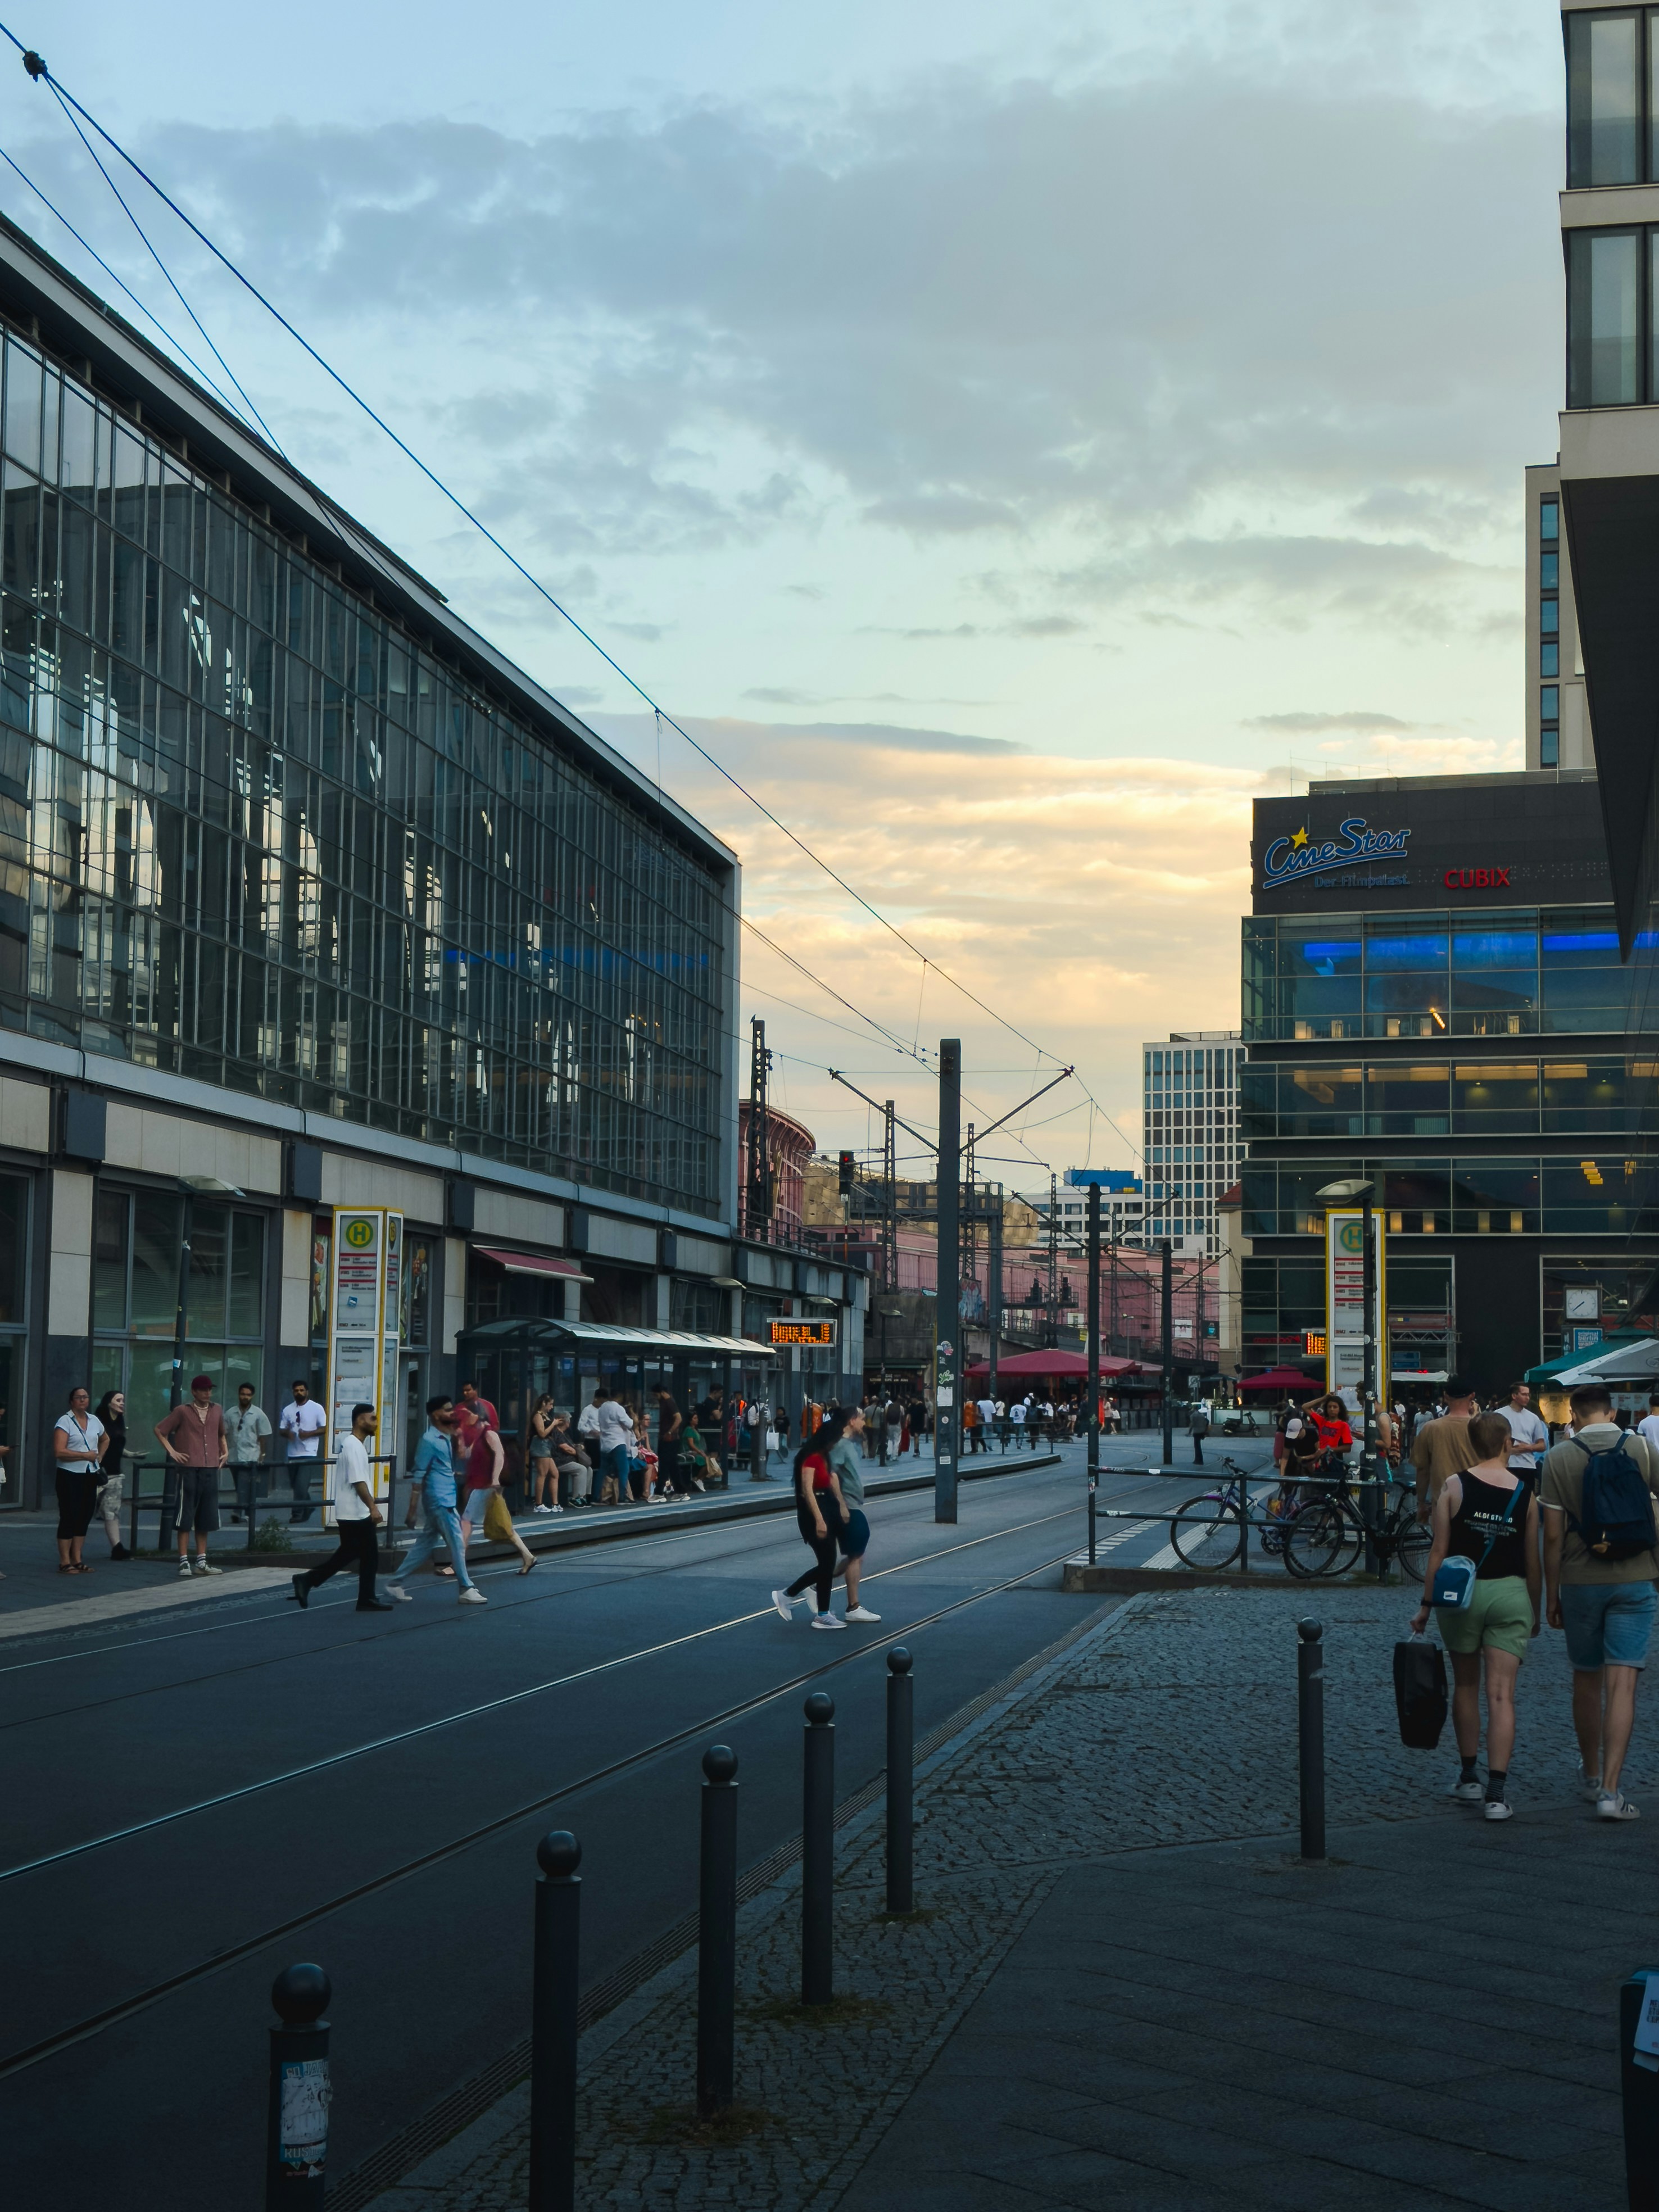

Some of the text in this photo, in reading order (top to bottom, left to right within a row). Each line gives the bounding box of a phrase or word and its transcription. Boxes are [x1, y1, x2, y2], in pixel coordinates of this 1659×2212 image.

[1264, 818, 1411, 877] CineStar
[1314, 876, 1336, 887] Der
[1444, 867, 1511, 889] CUBIX
